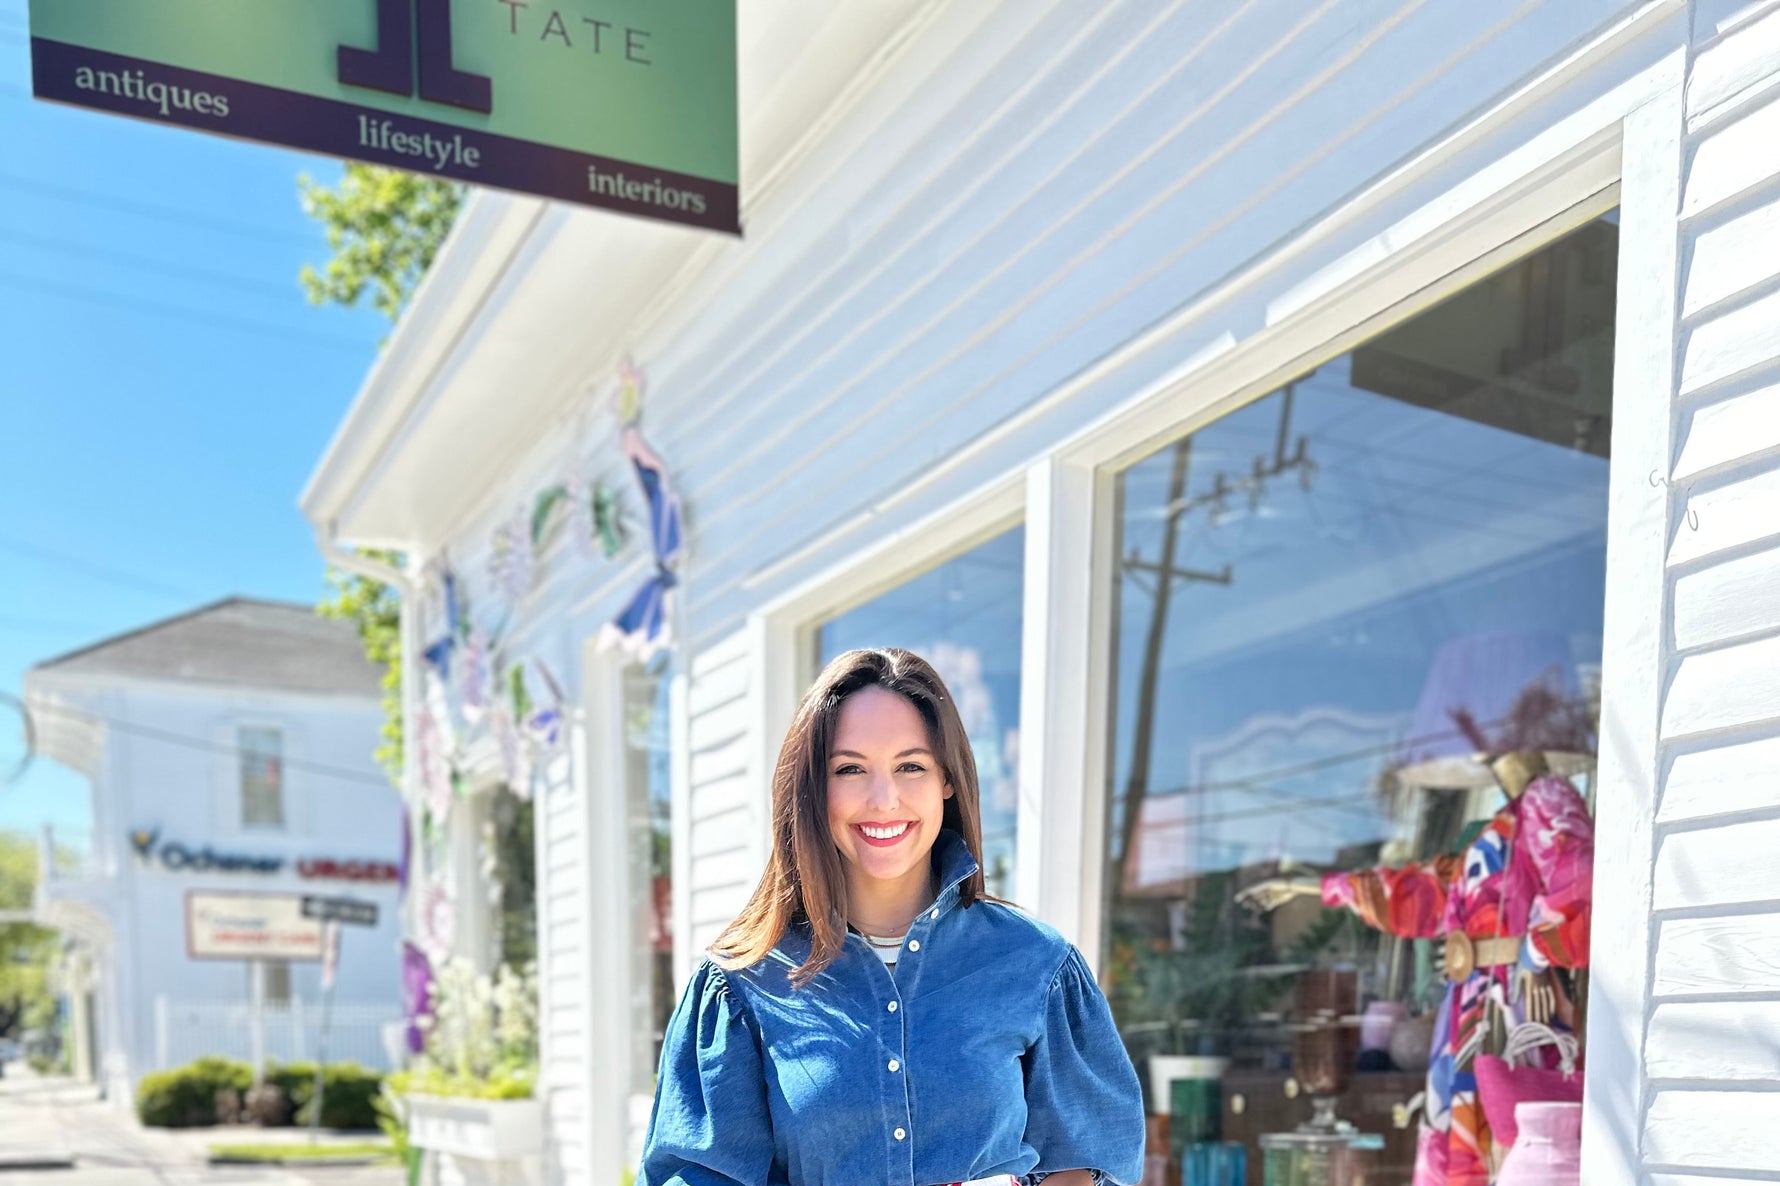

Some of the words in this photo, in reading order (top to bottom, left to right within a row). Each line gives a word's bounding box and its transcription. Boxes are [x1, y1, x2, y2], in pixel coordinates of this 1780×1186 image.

[500, 0, 652, 66] TATE
[75, 66, 230, 118] antiques
[358, 114, 480, 170] lifestyle
[588, 165, 706, 214] interiors
